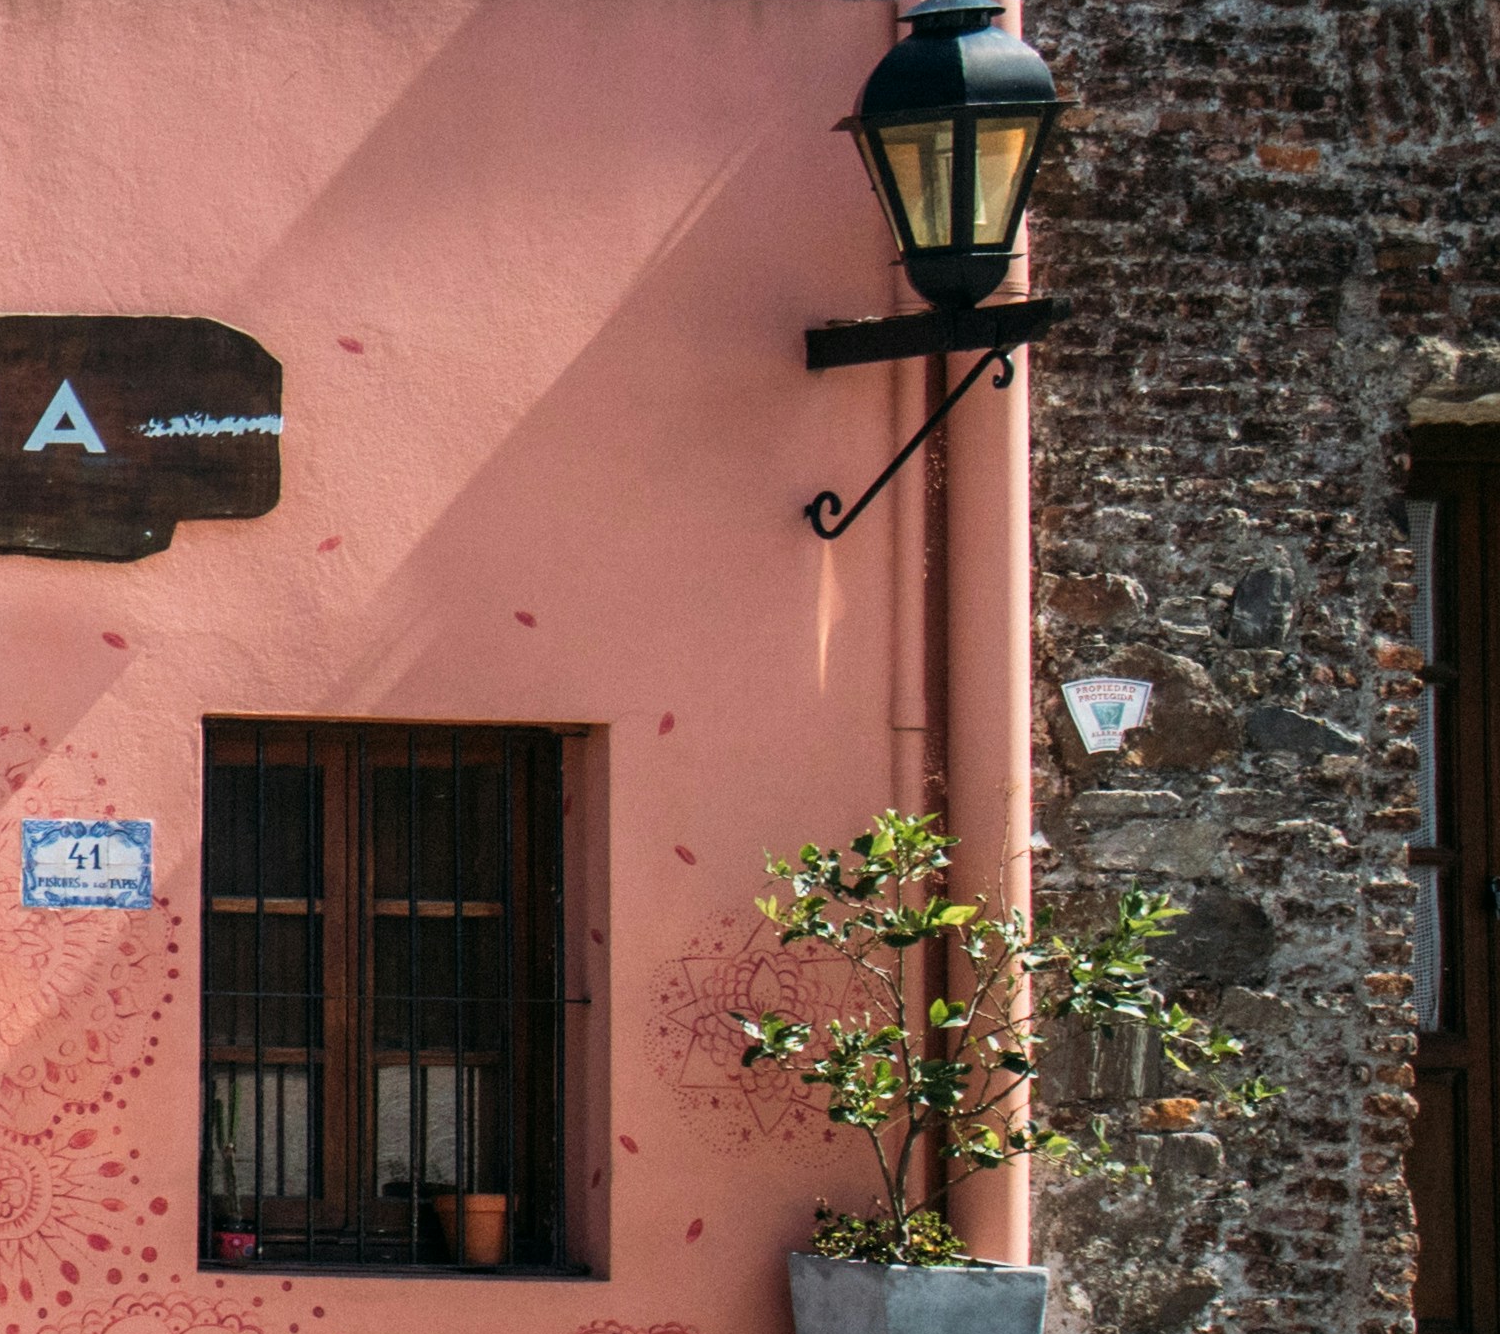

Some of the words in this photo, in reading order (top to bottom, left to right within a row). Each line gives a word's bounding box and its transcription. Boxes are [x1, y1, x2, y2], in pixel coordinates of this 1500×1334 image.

[1076, 684, 1136, 694] PROPIEDAD
[1078, 693, 1134, 703] PROTEGIDA
[68, 841, 102, 870] 41
